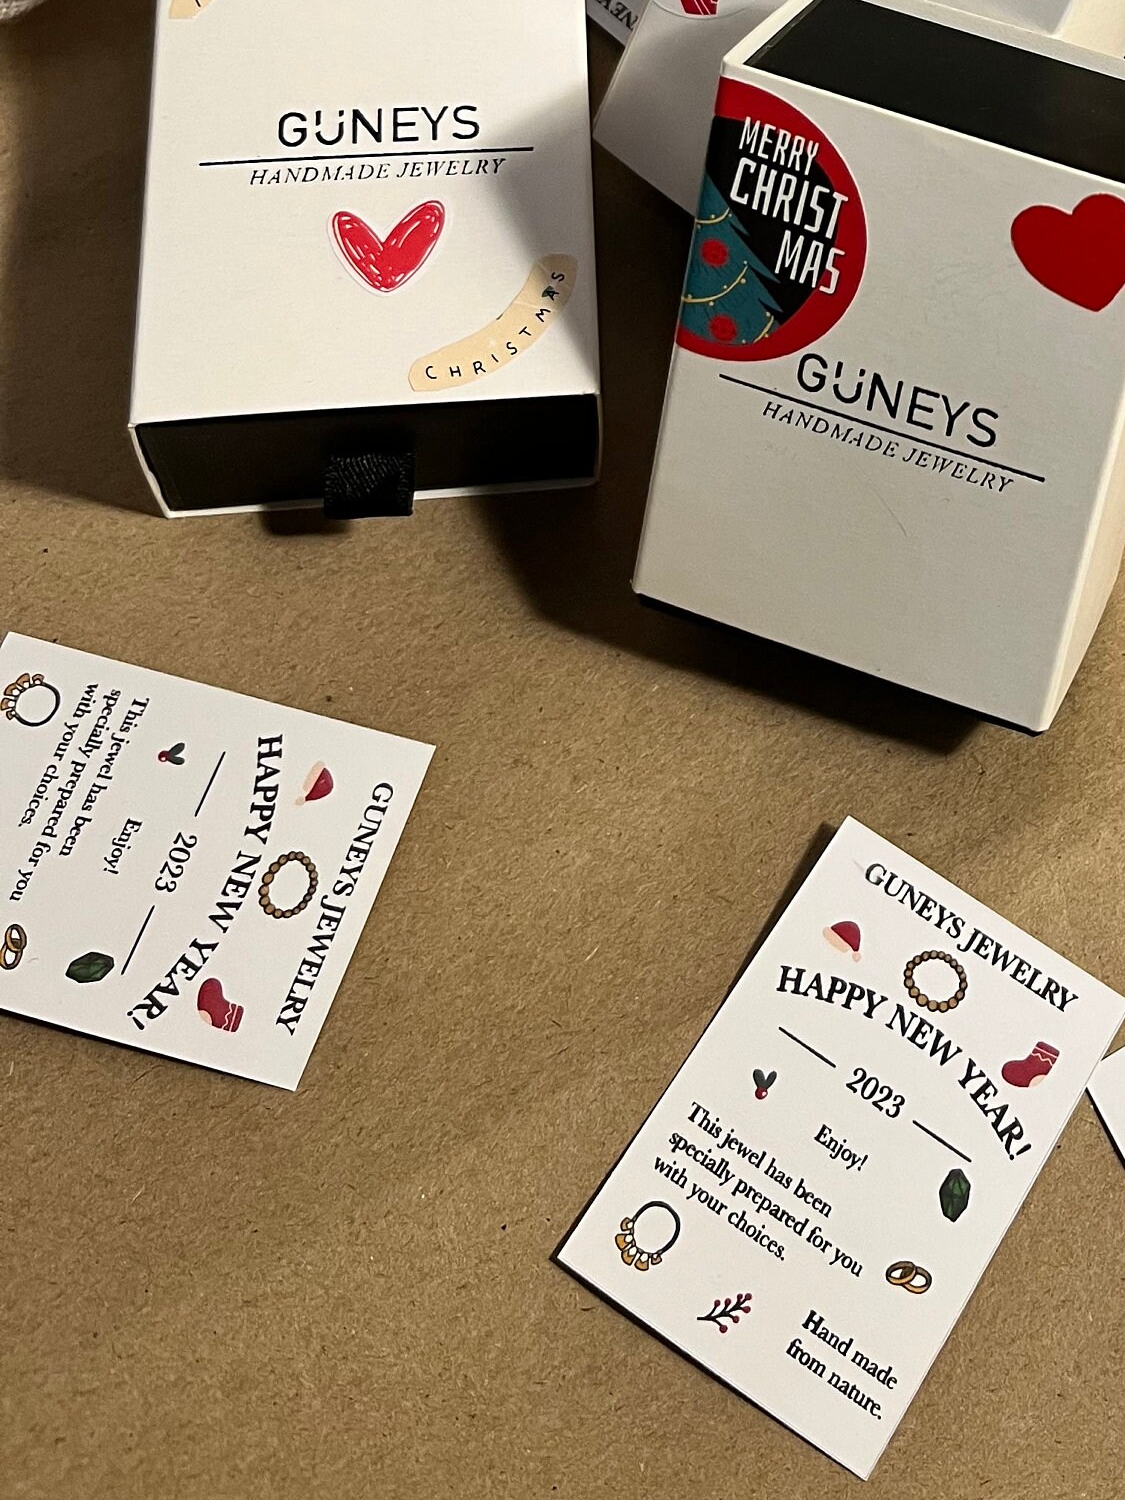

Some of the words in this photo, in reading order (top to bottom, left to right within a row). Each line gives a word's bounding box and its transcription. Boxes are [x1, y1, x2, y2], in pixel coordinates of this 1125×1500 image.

[250, 163, 390, 185] HANDMADE
[396, 158, 506, 178] JEWELRY
[738, 116, 819, 172] MERRY
[730, 157, 848, 239] CHRIST
[774, 229, 845, 294] MAS
[426, 271, 565, 381] CHRISTMAS
[762, 401, 899, 458] HANDMADE
[902, 448, 1014, 493] JEWELRY
[72, 683, 98, 718] with
[77, 689, 121, 759] specially
[118, 697, 149, 733] This
[52, 721, 79, 761] your
[96, 732, 129, 780] jewel
[17, 764, 59, 827] choices.
[40, 759, 86, 838] prepared
[80, 782, 108, 811] has
[243, 733, 282, 845] HAPPY
[27, 840, 51, 867] for
[58, 815, 92, 855] been
[103, 817, 142, 874] Enjoy!
[154, 831, 197, 892] 2023
[331, 782, 394, 897] GUNEYS
[8, 868, 33, 901] you
[207, 850, 262, 934] NEW
[275, 894, 346, 1035] JEWELRY
[864, 863, 966, 938] GUNEYS
[956, 927, 1078, 1012] JEWELRY
[126, 937, 219, 1030] YEAR!
[775, 965, 888, 1019] HAPPY
[884, 1003, 963, 1066] NEW
[957, 1057, 1031, 1160] YEAR!
[845, 1067, 905, 1118] 2023
[687, 1101, 722, 1138] This
[716, 1128, 766, 1168] jewel
[763, 1157, 792, 1189] has
[792, 1178, 831, 1218] been
[813, 1123, 867, 1171] Enjoy!
[654, 1156, 687, 1189] with
[685, 1182, 727, 1215] your
[727, 1210, 784, 1261] choices.
[668, 1132, 735, 1186] specially
[730, 1178, 808, 1236] prepared
[805, 1225, 832, 1253] for
[829, 1247, 862, 1277] you
[785, 1338, 826, 1378] from
[826, 1371, 881, 1419] nature.
[801, 1309, 853, 1357] Hand
[850, 1350, 897, 1389] made
